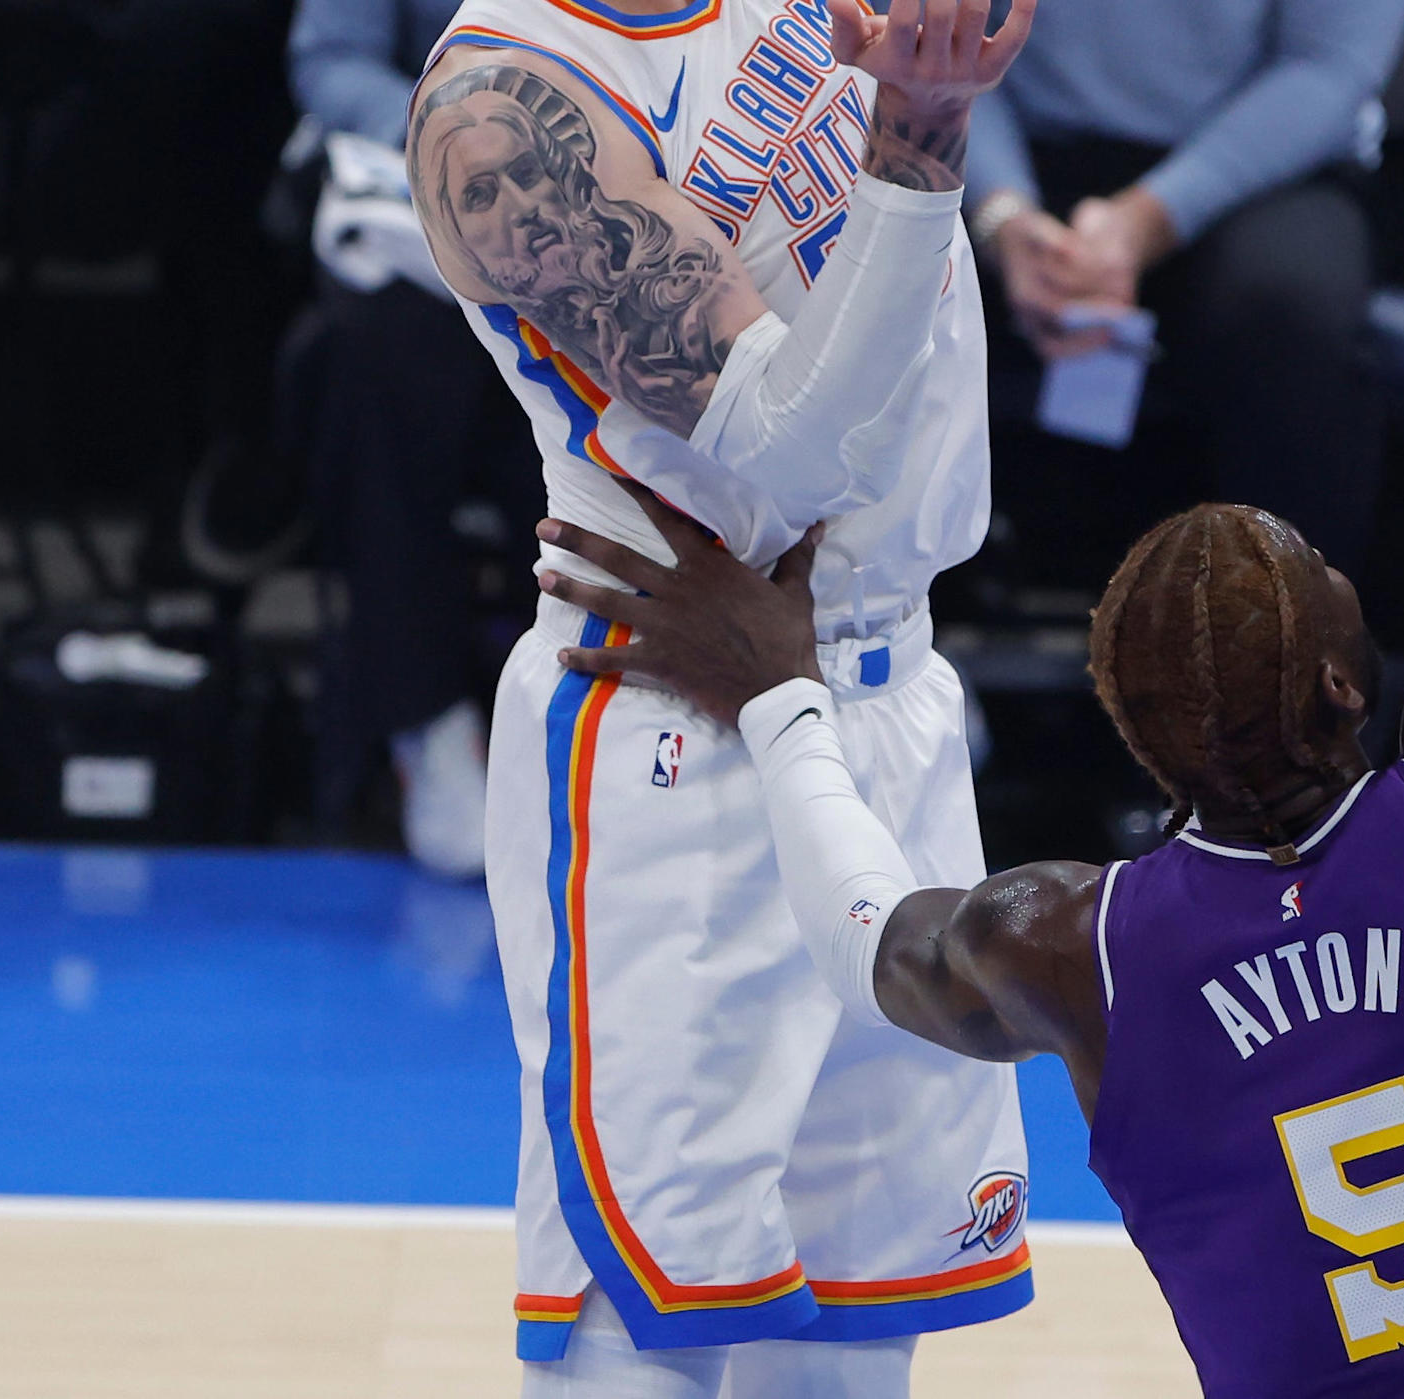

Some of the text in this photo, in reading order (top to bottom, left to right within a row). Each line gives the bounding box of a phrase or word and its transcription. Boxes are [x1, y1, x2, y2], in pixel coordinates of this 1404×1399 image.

[767, 76, 873, 228] CITY
[1200, 927, 1402, 1060] AYTON
[961, 1182, 1015, 1249] OKC
